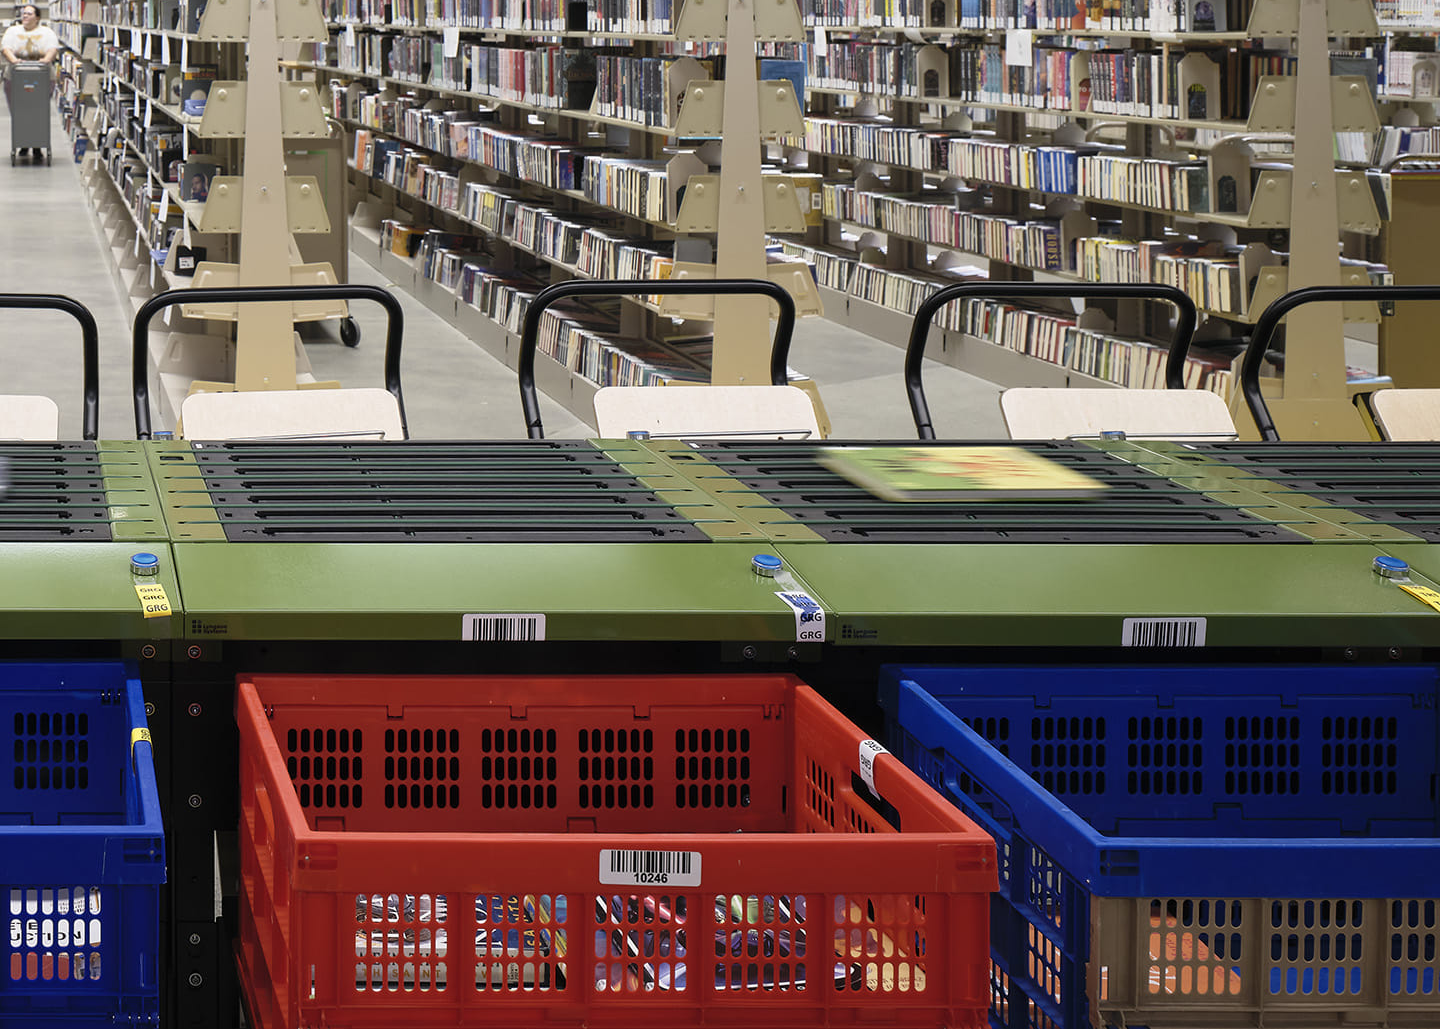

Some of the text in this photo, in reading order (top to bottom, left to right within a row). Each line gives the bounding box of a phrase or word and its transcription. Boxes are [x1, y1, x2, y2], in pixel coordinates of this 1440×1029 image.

[146, 604, 168, 612] GRG
[800, 612, 822, 622] GRG
[800, 631, 822, 639] GRG
[634, 873, 668, 883] 10246
